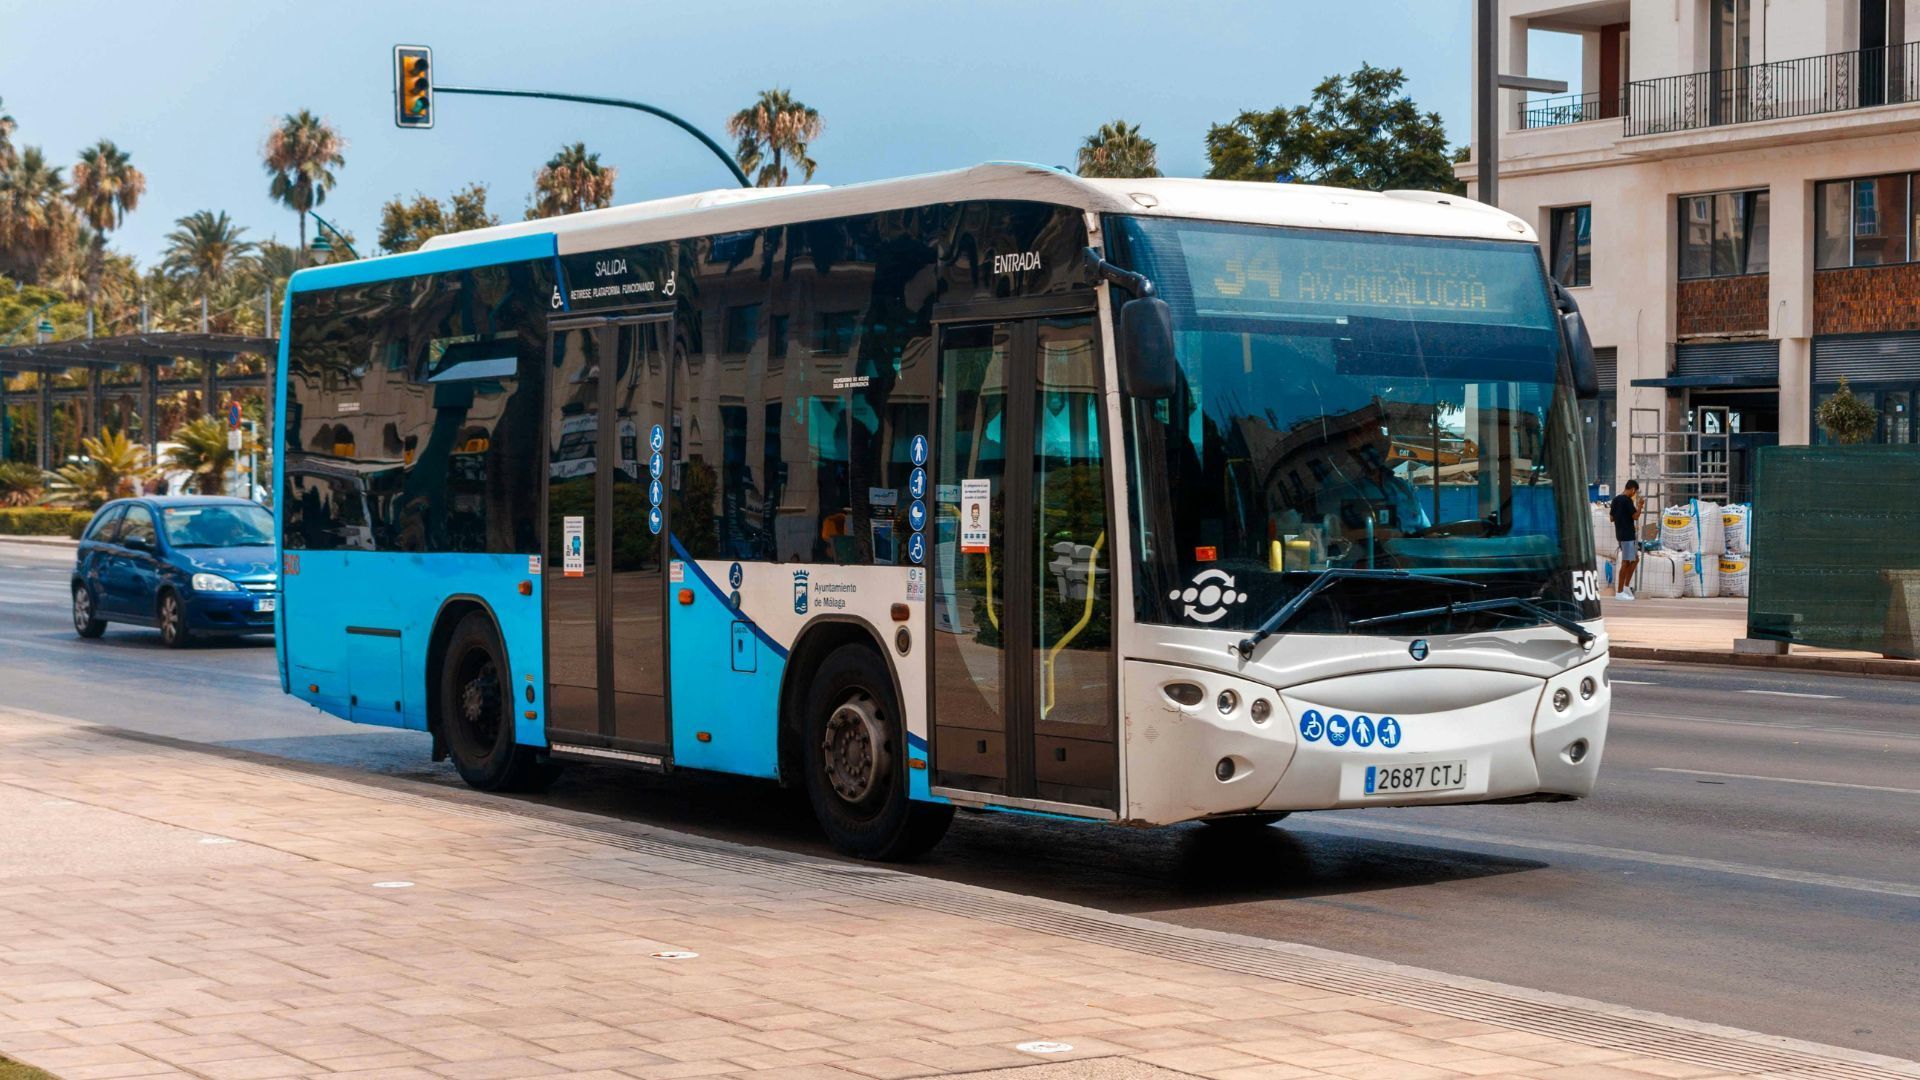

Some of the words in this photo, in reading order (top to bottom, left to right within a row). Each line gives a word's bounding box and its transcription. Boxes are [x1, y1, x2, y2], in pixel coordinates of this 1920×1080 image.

[595, 258, 628, 277] SALIDA
[994, 251, 1041, 274] ENTRADA
[592, 285, 621, 298] PLATAFORMA
[622, 281, 655, 294] FUNCIONANDO
[1399, 449, 1410, 457] CAT
[814, 582, 857, 594] Ayuntamiento
[814, 598, 822, 607] de
[823, 597, 846, 609] Málaga
[1378, 768, 1425, 789] 2687
[1431, 764, 1462, 787] CTJ
